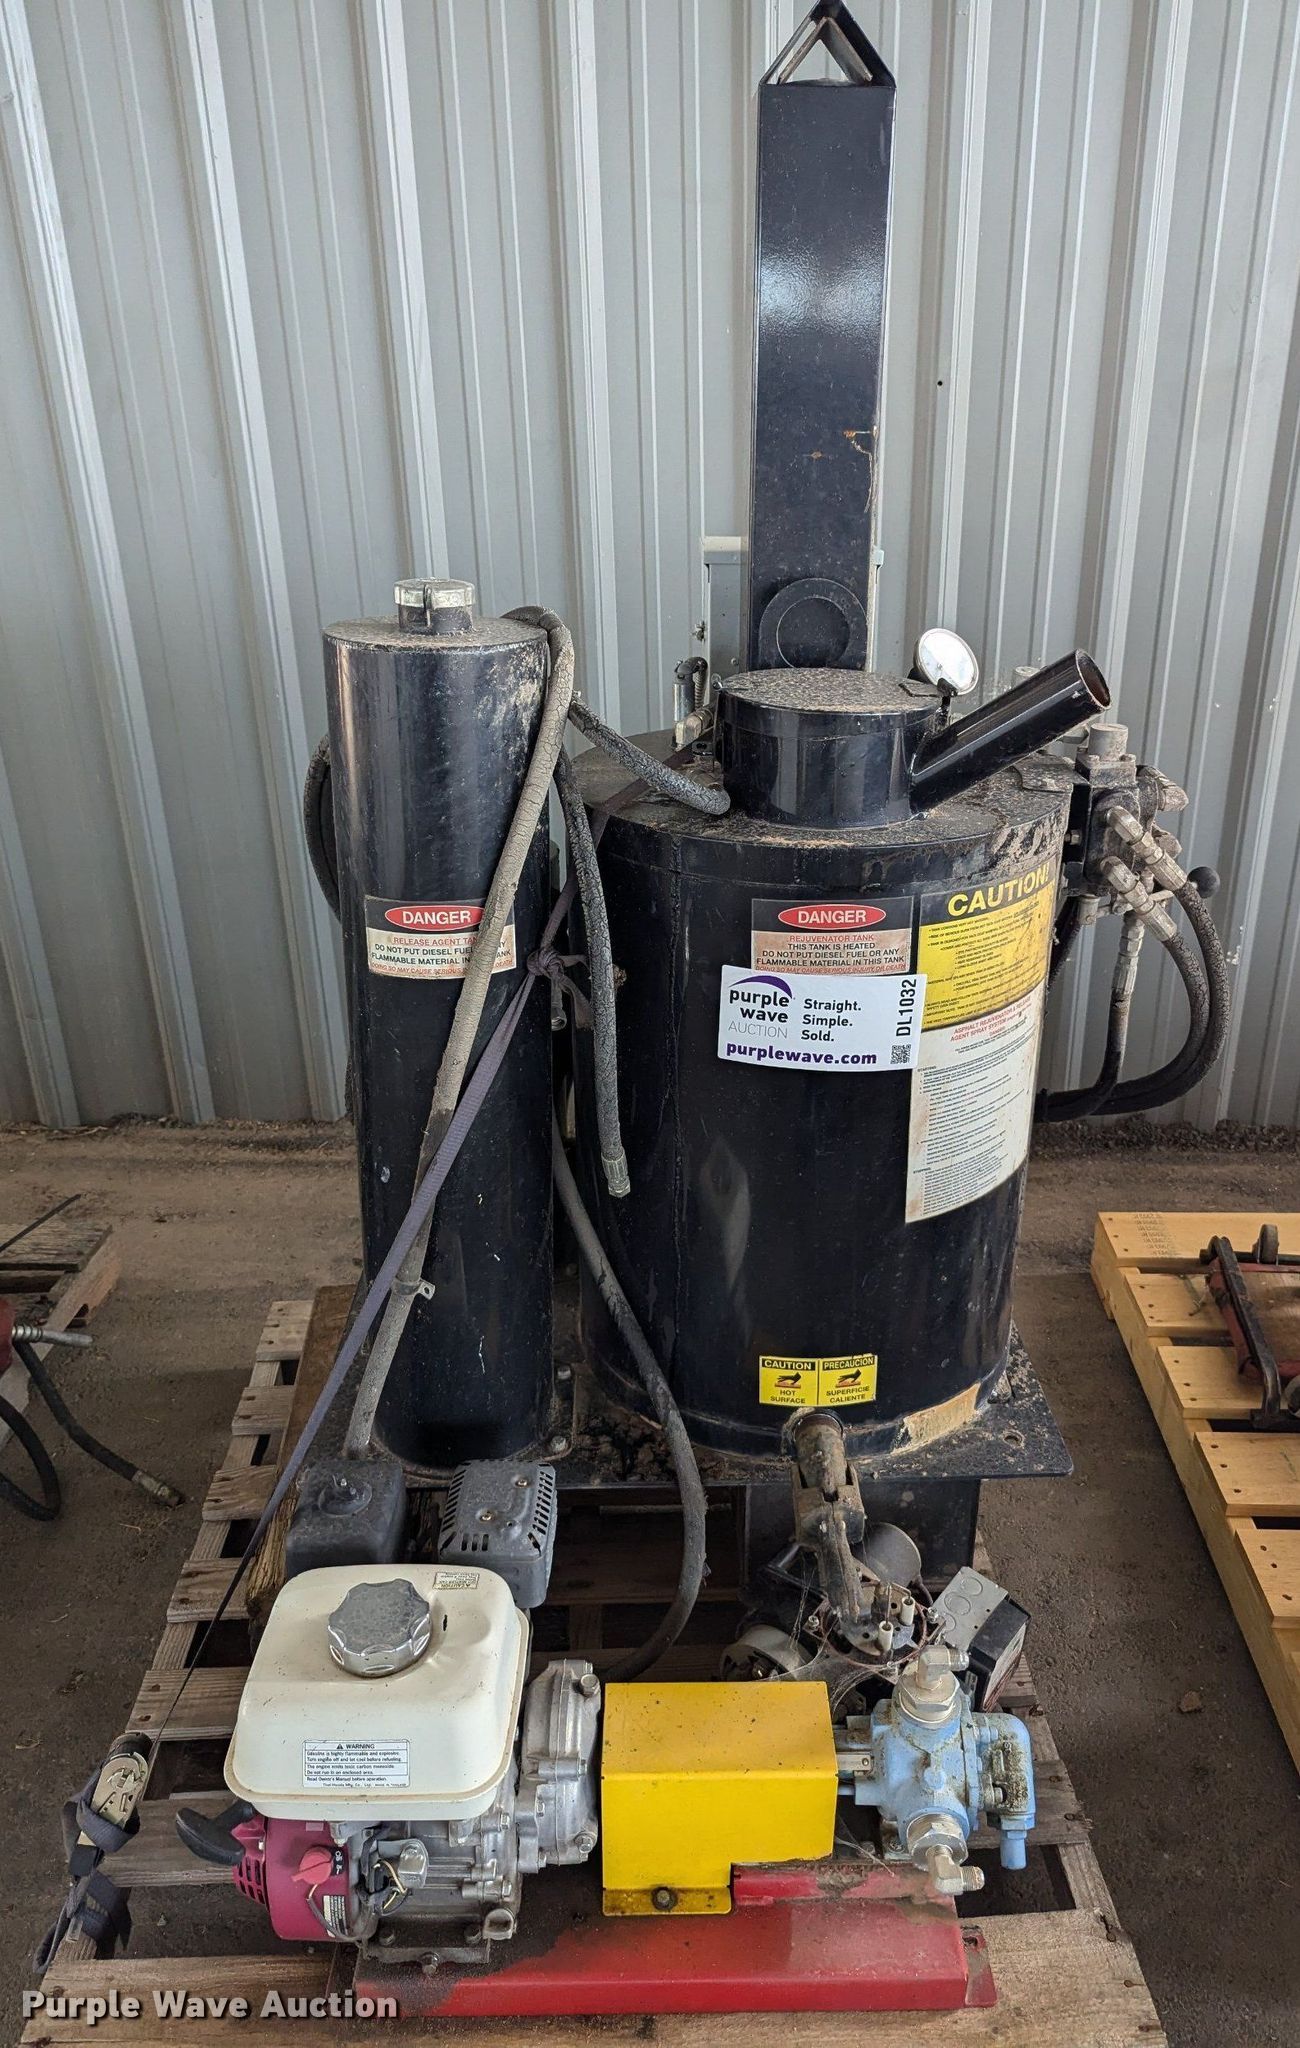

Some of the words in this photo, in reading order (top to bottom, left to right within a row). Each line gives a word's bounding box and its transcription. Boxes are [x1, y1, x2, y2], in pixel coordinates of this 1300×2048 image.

[402, 910, 471, 924] DANGER
[797, 910, 866, 924] DANGER
[394, 937, 429, 946] RELEASE
[463, 937, 477, 945] TAN
[372, 952, 416, 964] FLAMMABLE
[496, 950, 511, 958] ANK
[756, 958, 807, 966] FLAMMABLE
[729, 989, 790, 1008] purple
[804, 998, 862, 1012] Straight.
[896, 979, 916, 1037] DL1032
[740, 1009, 788, 1022] wave
[802, 1015, 853, 1027] Simple.
[728, 1020, 788, 1039] AUCTION
[801, 1030, 834, 1041] Sold.
[726, 1043, 877, 1065] purplewave.com
[764, 1360, 812, 1370] CAUTION
[826, 1386, 869, 1396] SUPERFICIE
[830, 1394, 865, 1403] CALIENTE
